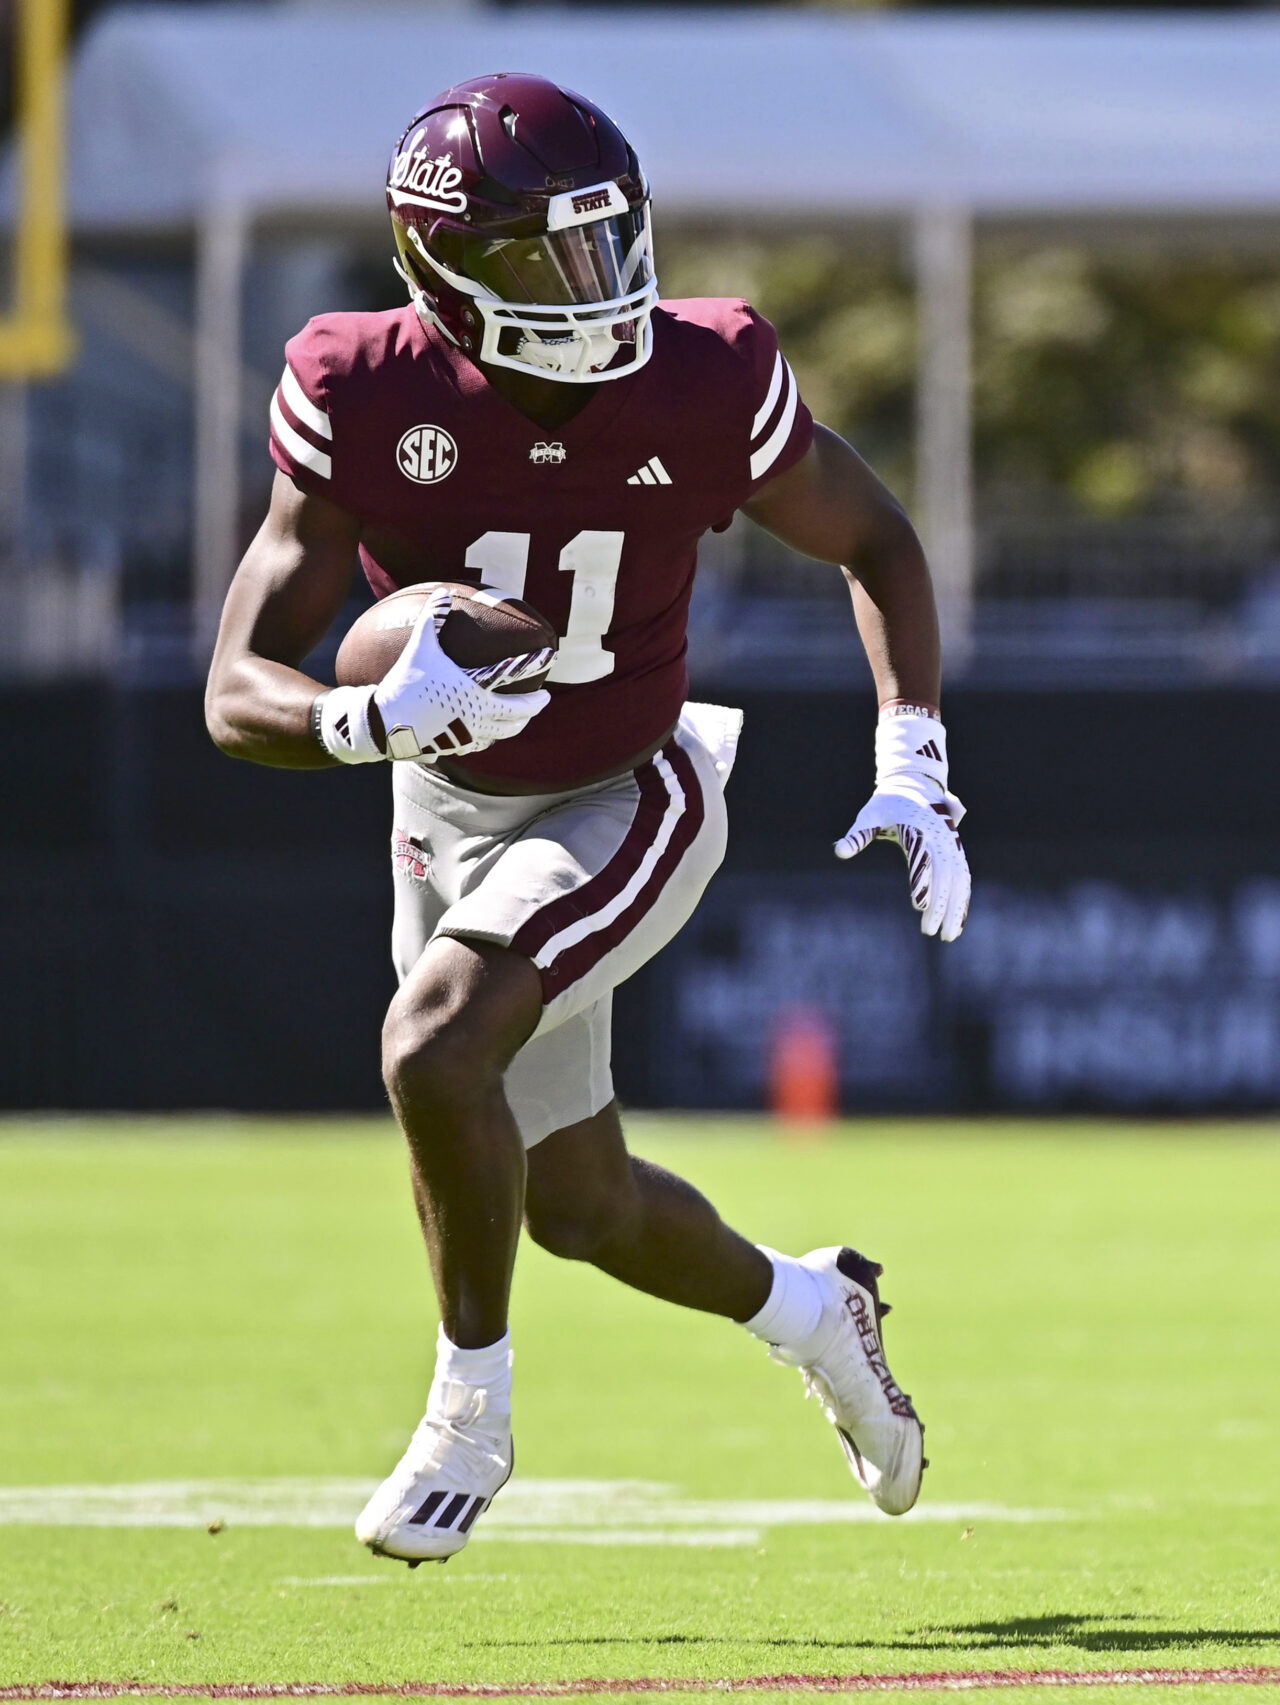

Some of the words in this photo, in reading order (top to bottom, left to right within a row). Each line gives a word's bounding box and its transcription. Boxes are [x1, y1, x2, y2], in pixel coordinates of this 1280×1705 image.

[387, 127, 467, 213] State
[572, 195, 612, 214] STATE
[401, 429, 453, 480] SEC
[844, 1290, 917, 1420] ADIZERO
